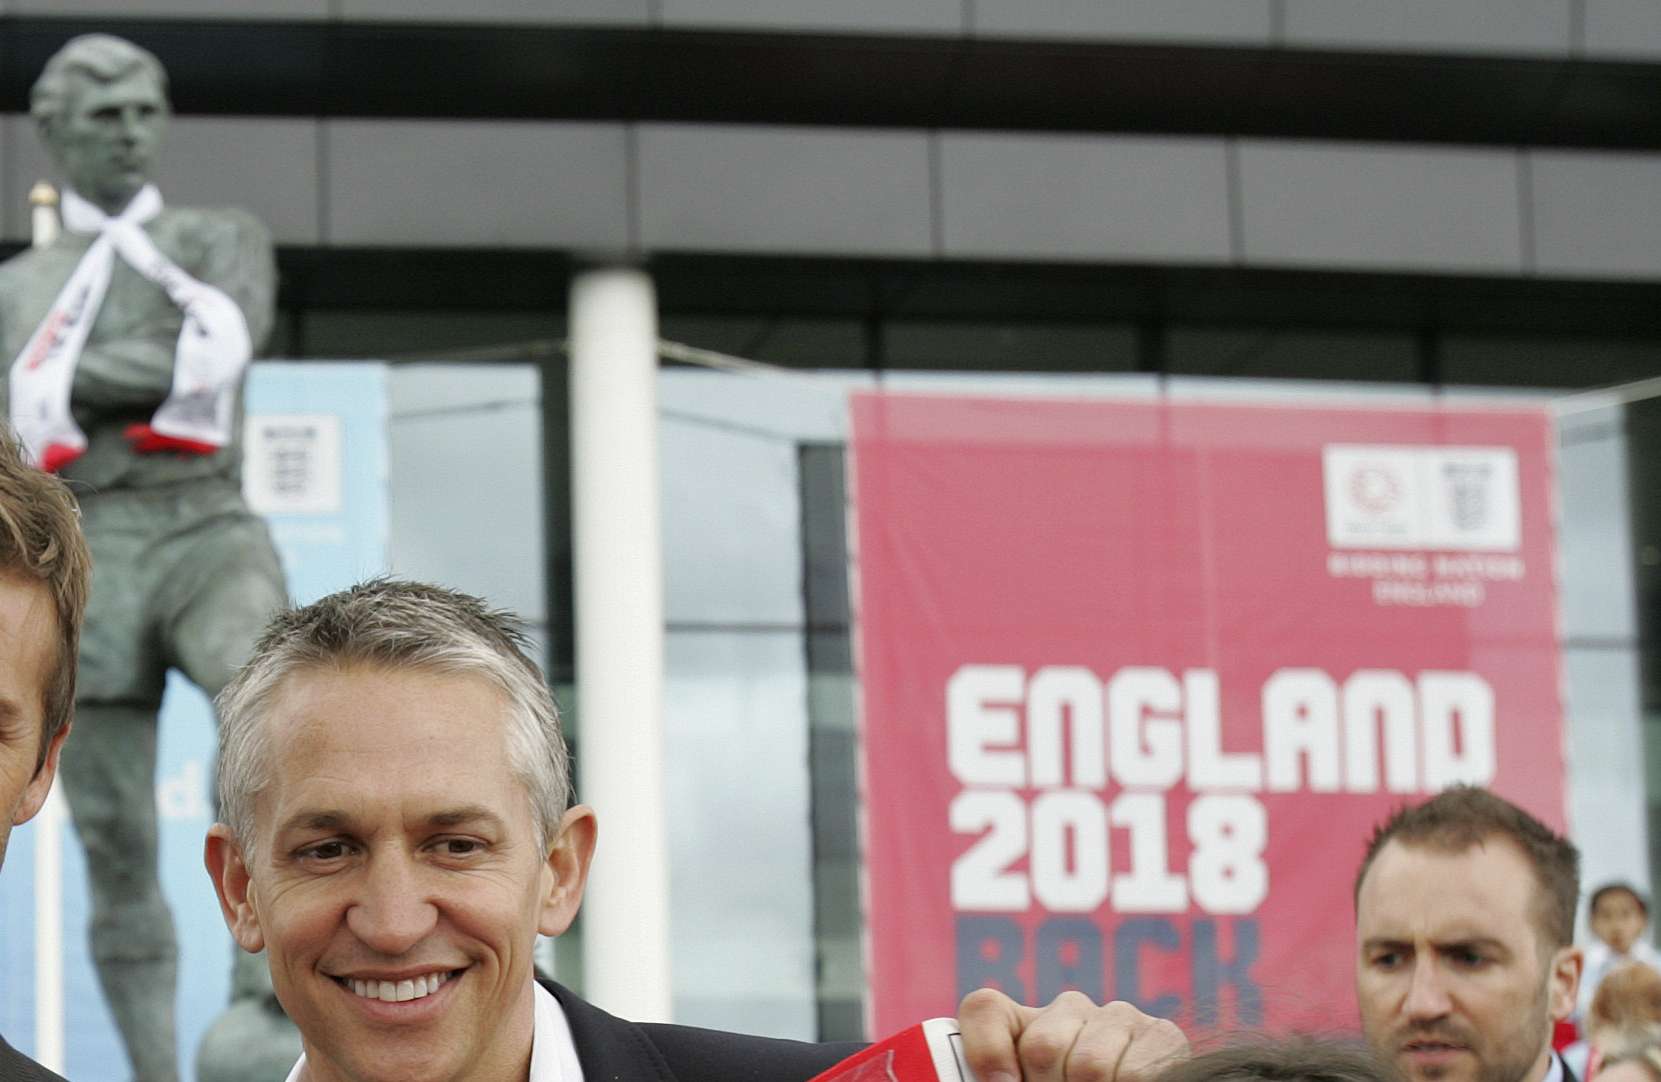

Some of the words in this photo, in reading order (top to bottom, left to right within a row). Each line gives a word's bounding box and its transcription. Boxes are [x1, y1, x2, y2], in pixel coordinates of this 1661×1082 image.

[946, 664, 1496, 794] ENGLAND
[948, 789, 1269, 915] 2018
[953, 916, 1262, 1028] BACK
